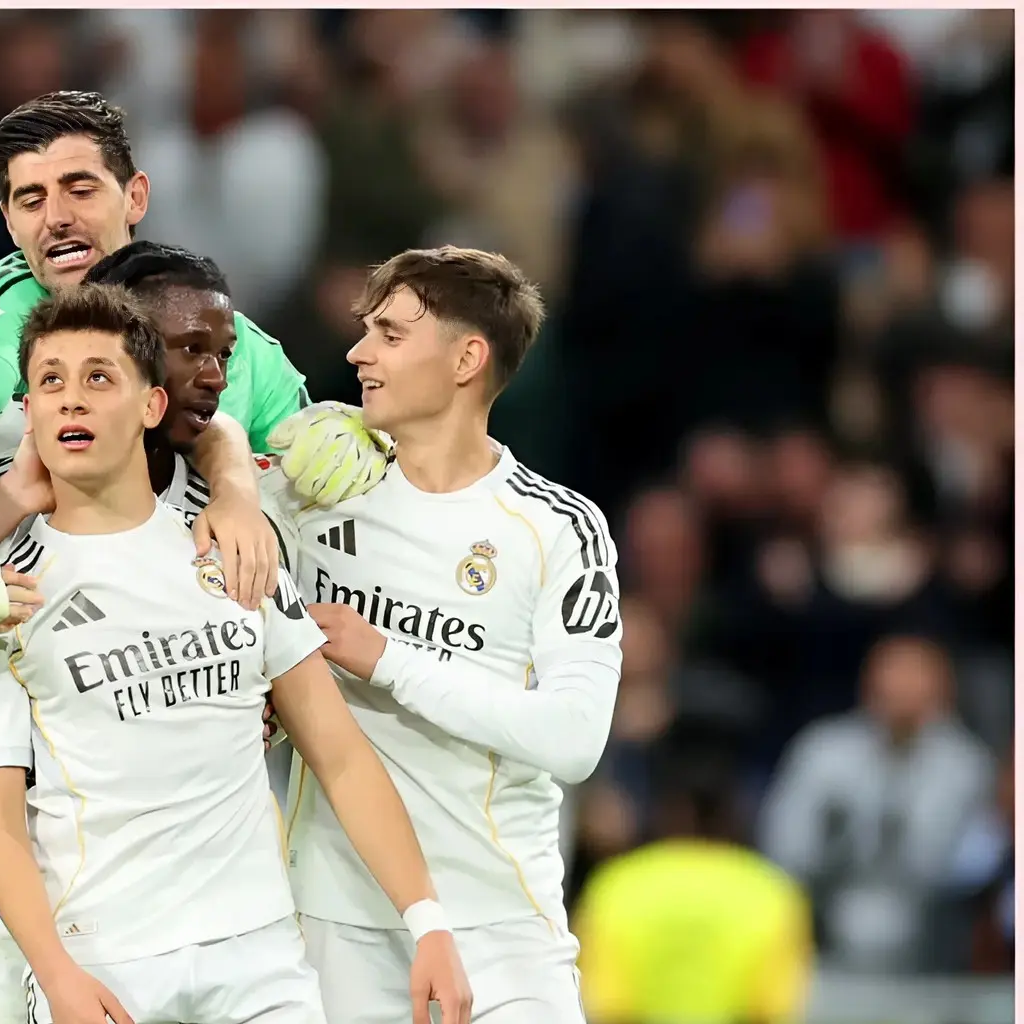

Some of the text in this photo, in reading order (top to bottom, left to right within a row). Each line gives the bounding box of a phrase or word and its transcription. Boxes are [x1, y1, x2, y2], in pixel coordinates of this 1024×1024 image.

[315, 566, 486, 651] Emirates
[64, 617, 257, 693] Emirates
[113, 659, 240, 721] FLY BETTER
